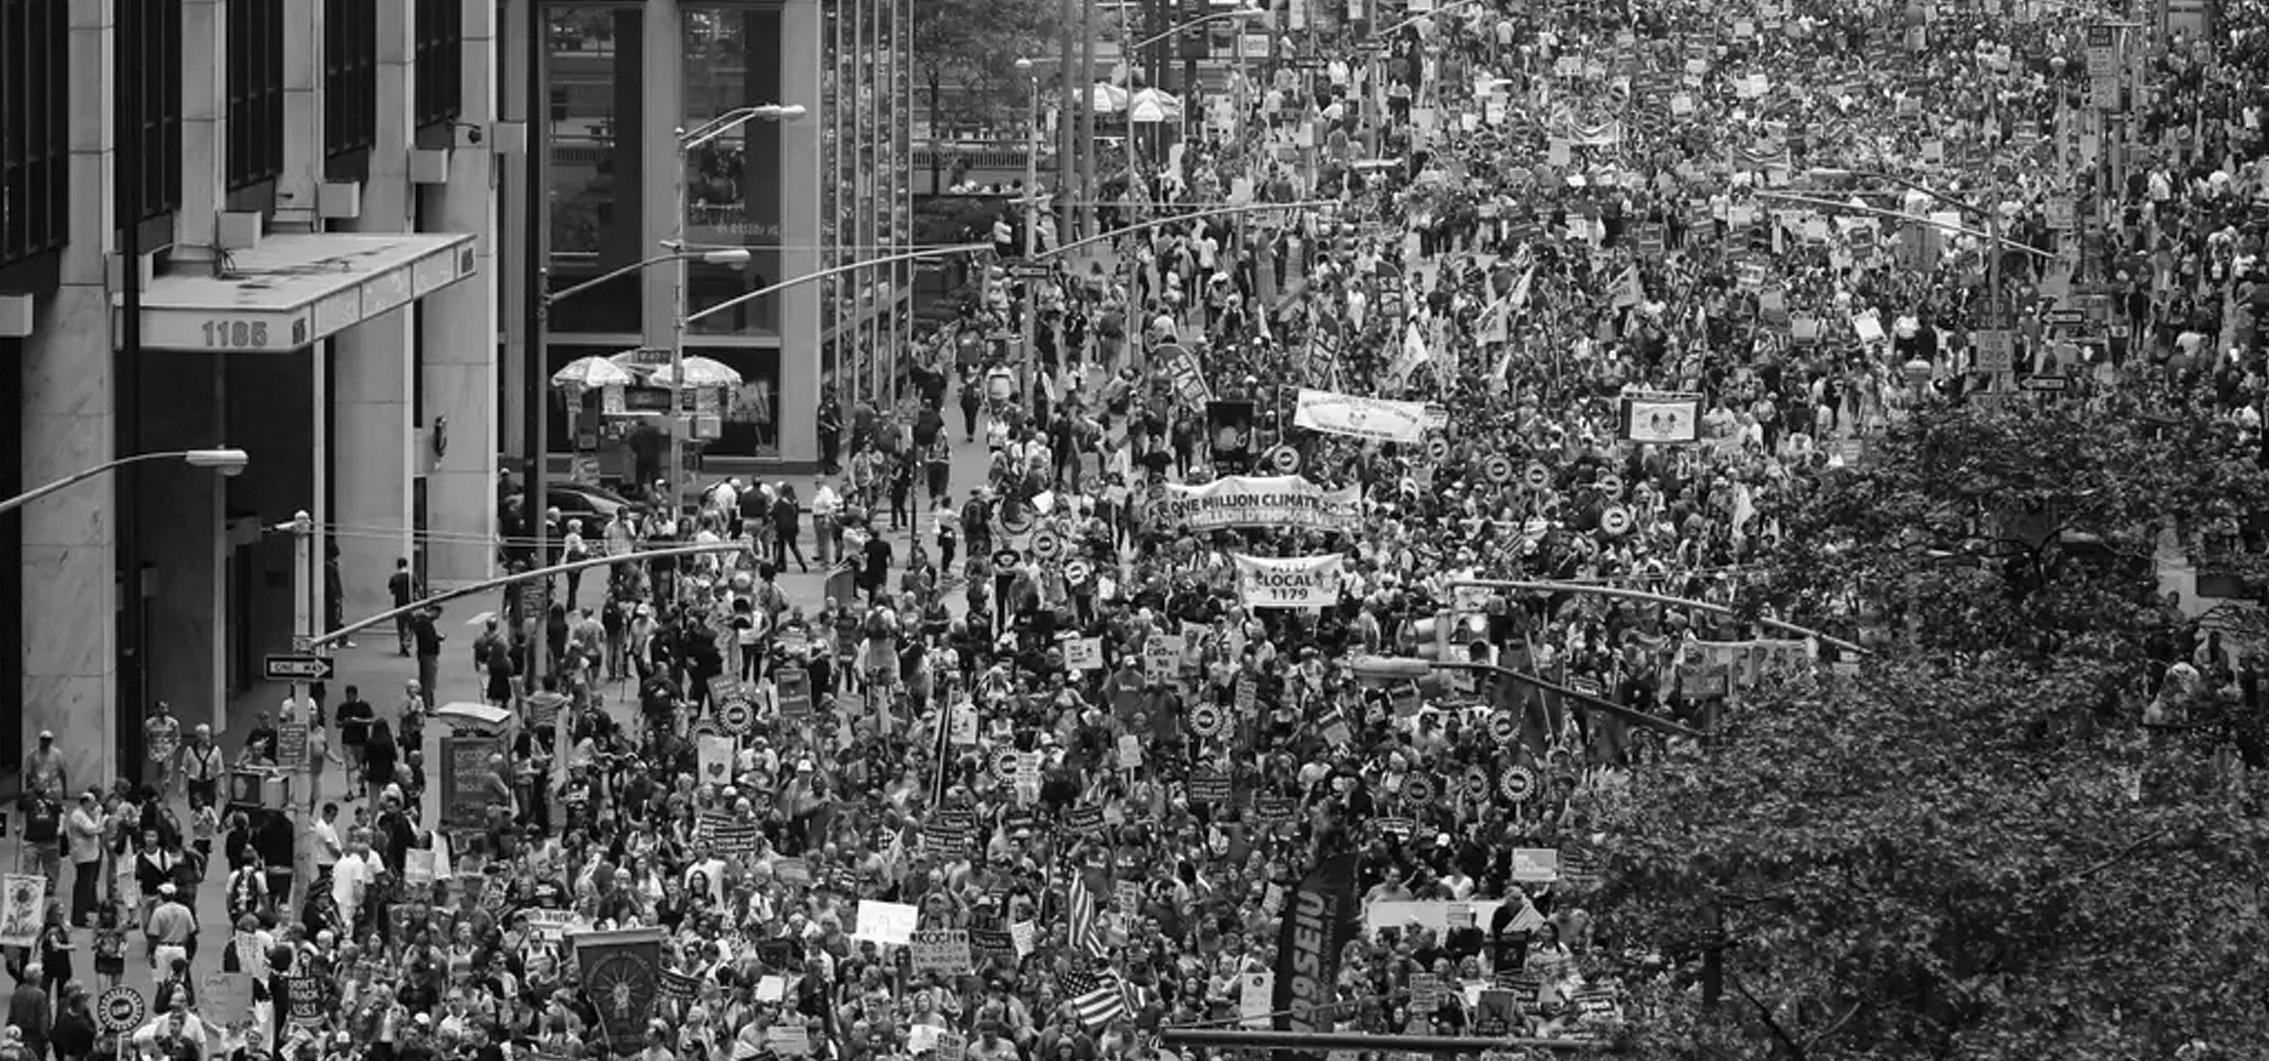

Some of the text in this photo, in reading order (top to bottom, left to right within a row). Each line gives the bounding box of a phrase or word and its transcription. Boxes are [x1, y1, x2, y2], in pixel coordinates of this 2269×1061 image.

[202, 320, 268, 347] 1185
[1171, 500, 1199, 514] ONE
[1202, 494, 1259, 511] MILLION
[1264, 574, 1314, 587] LOCAL
[1271, 588, 1308, 600] 1179
[1289, 890, 1325, 1034] 199SEIU
